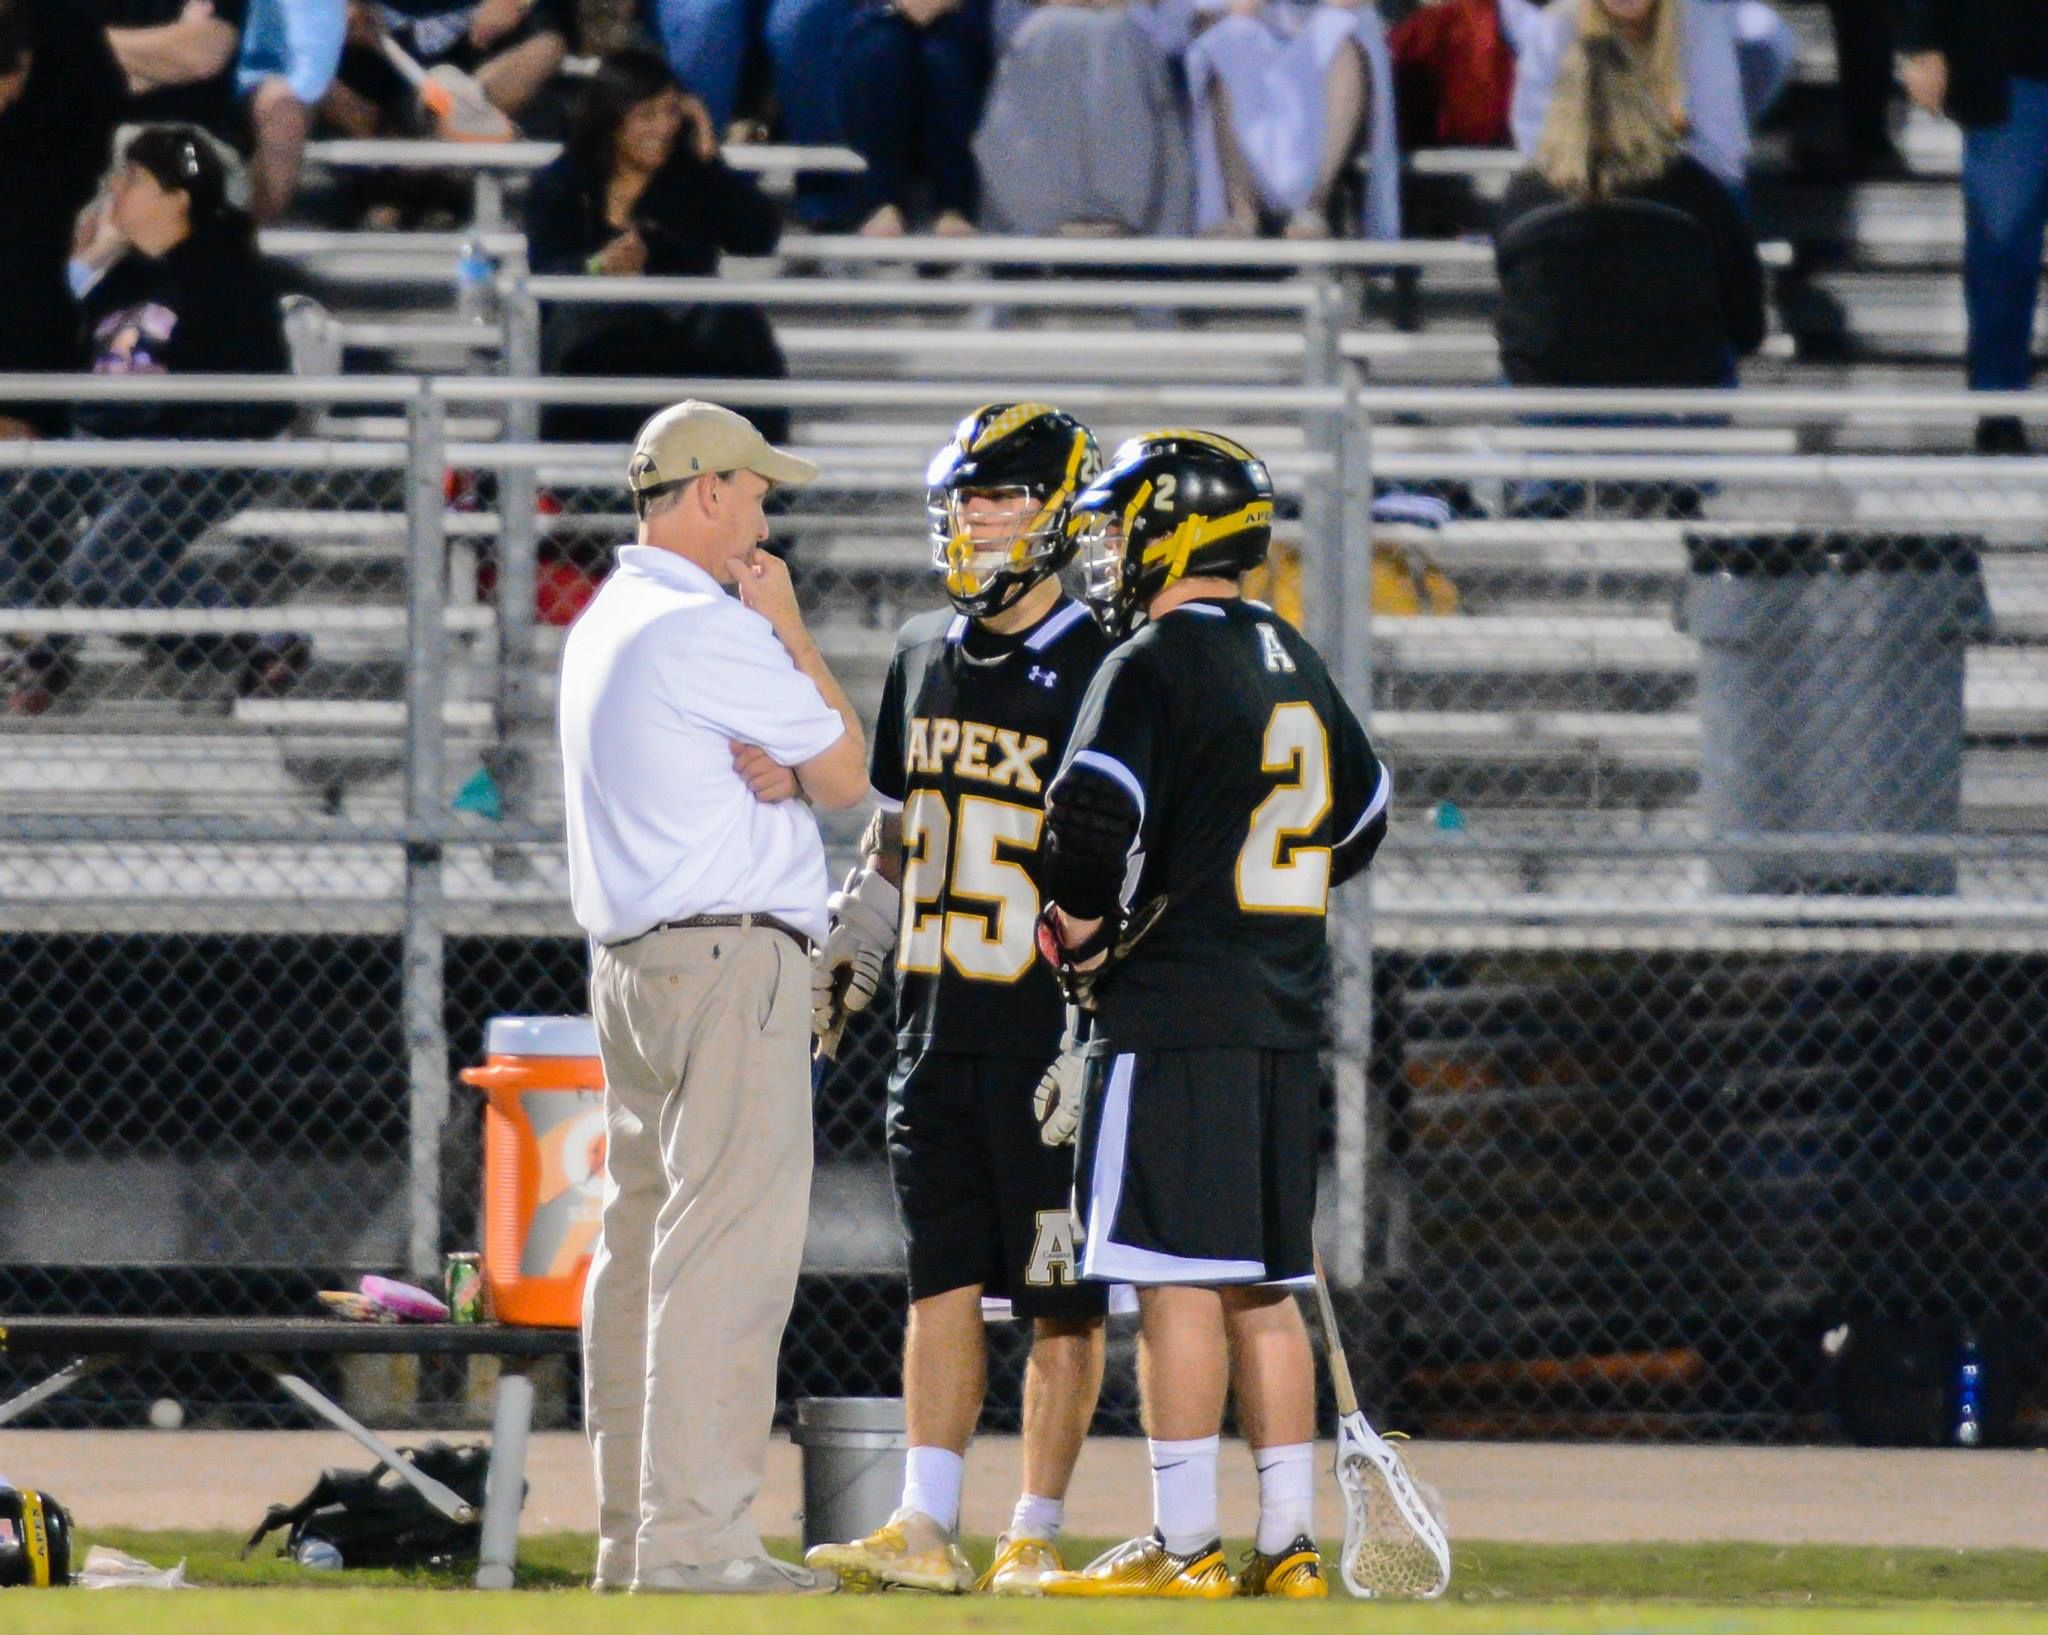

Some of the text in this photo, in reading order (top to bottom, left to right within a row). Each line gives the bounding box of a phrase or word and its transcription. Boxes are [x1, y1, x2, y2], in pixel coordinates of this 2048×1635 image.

[1153, 473, 1177, 511] 2
[1256, 622, 1297, 673] A
[905, 716, 1049, 794] APEX
[1234, 701, 1334, 916] 2
[895, 788, 1045, 984] 25
[1025, 1208, 1079, 1286] A
